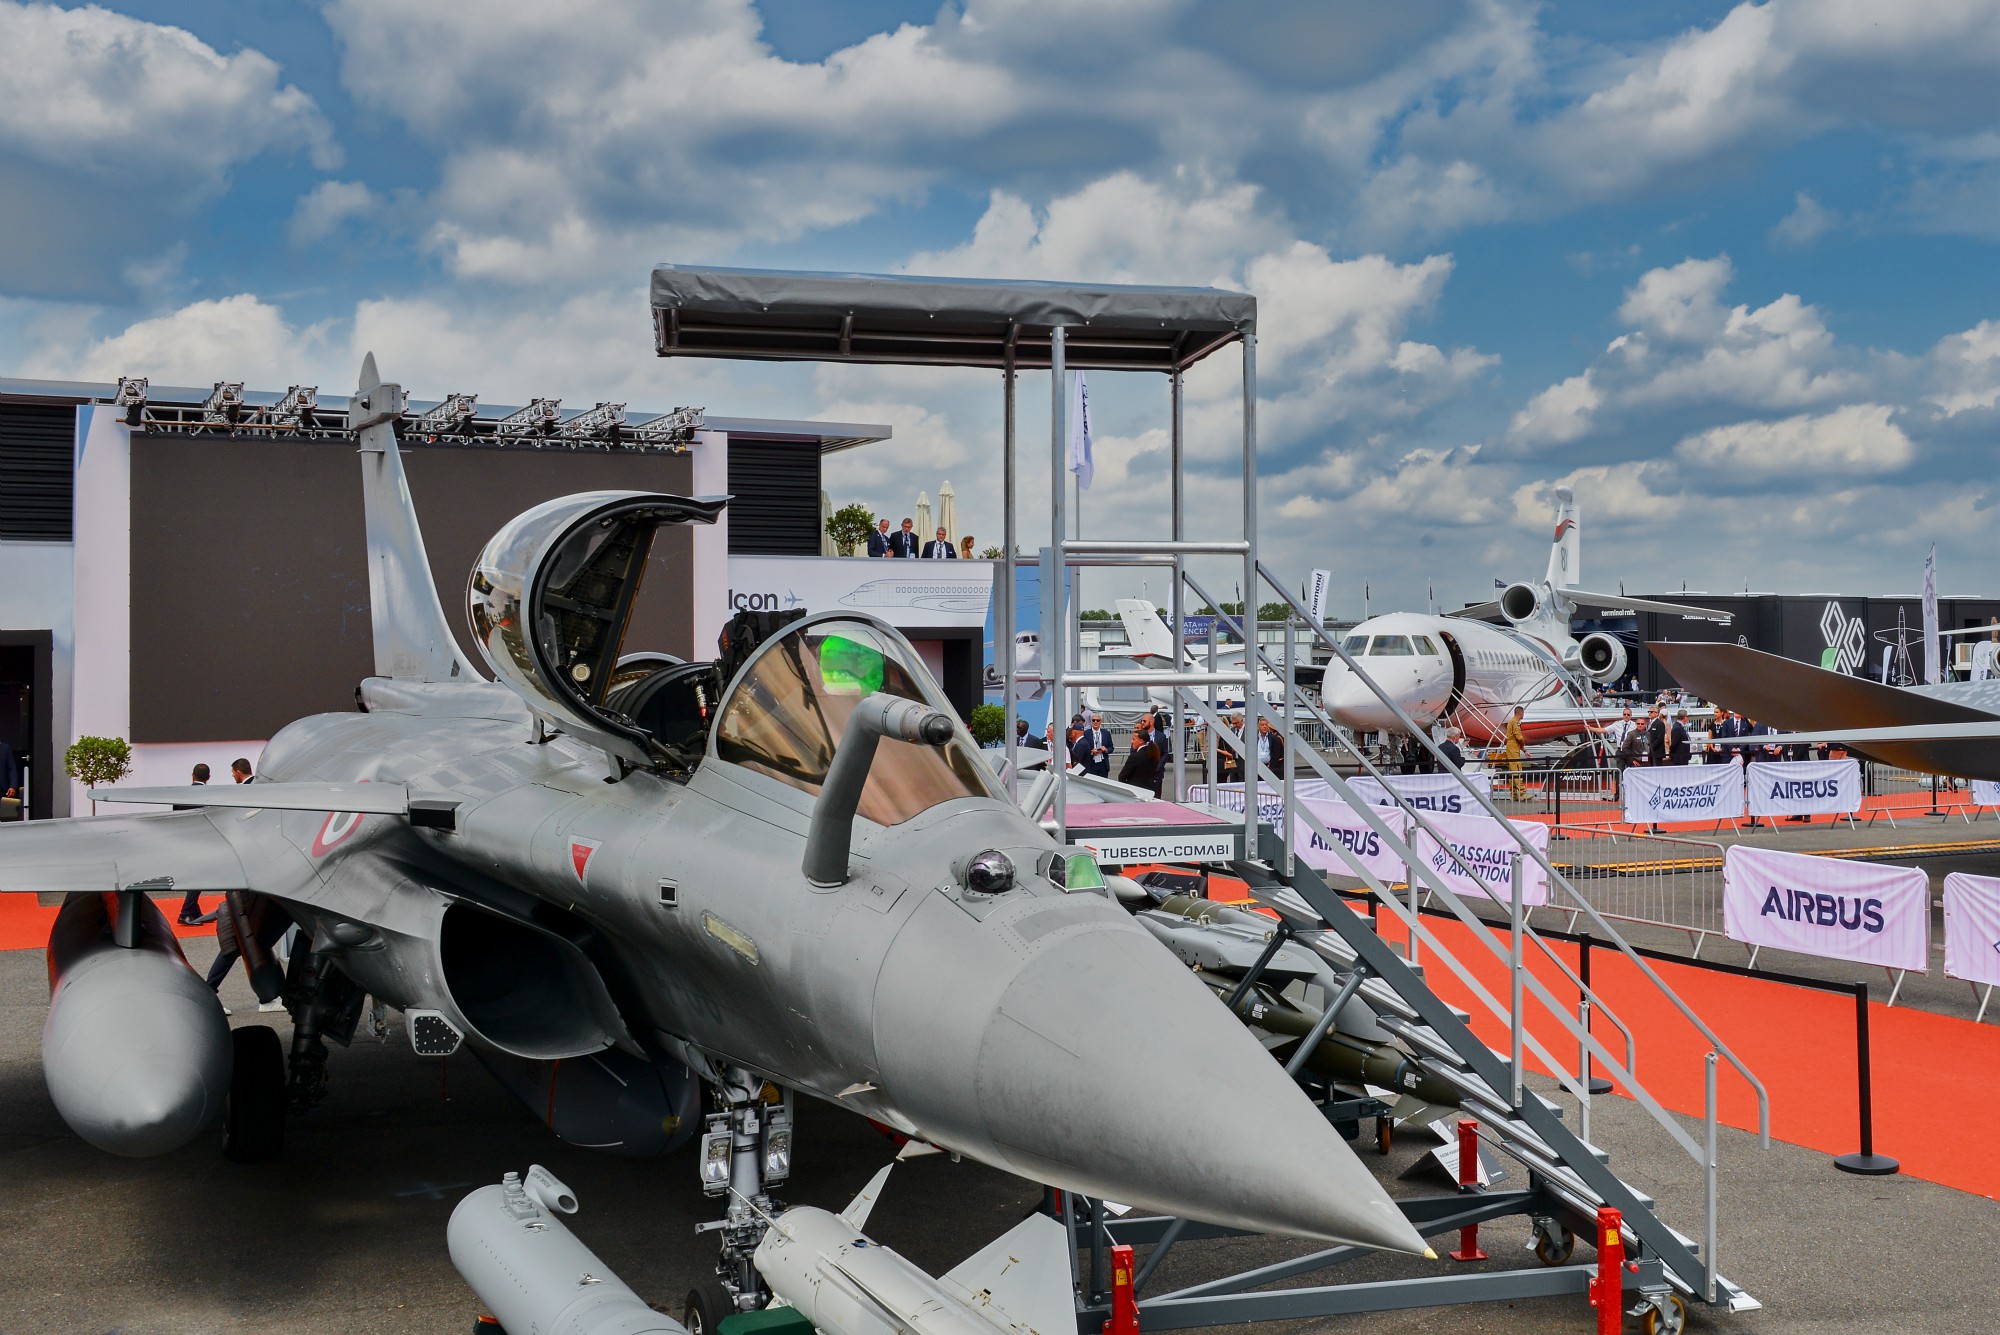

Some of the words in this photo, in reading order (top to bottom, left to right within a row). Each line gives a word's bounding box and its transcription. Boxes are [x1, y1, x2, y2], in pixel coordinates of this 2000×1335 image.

[1312, 573, 1322, 615] Diamond
[1663, 784, 1721, 798] DASSAULT
[1770, 780, 1838, 799] AIRBUS
[1662, 796, 1716, 810] AVIATION
[1101, 844, 1229, 859] TUBESCA-COMABI
[1760, 886, 1885, 934] AIRBUS
